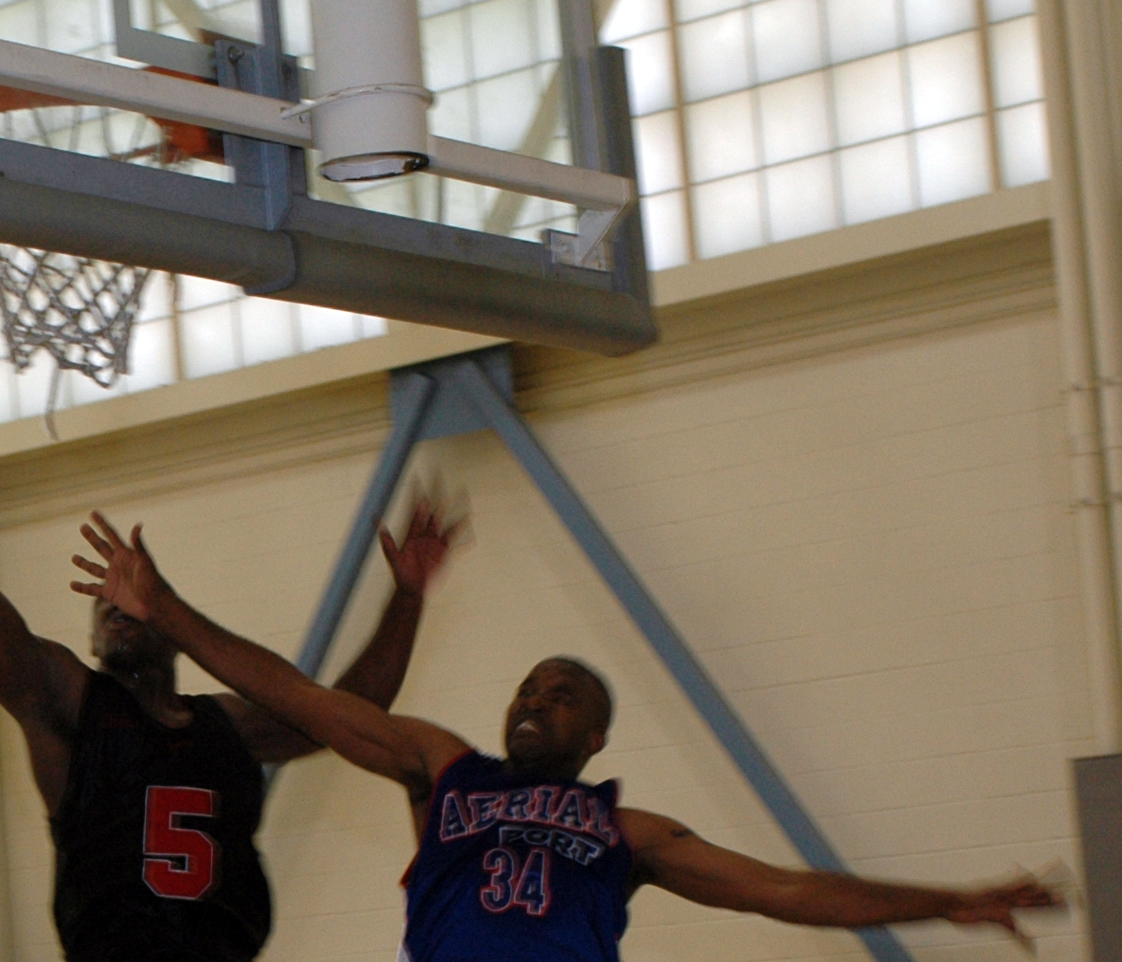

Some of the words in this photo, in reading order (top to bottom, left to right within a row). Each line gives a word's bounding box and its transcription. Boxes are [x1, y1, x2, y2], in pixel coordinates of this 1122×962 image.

[142, 785, 216, 900] 5
[439, 786, 619, 847] AERIAL
[480, 847, 551, 917] 34
